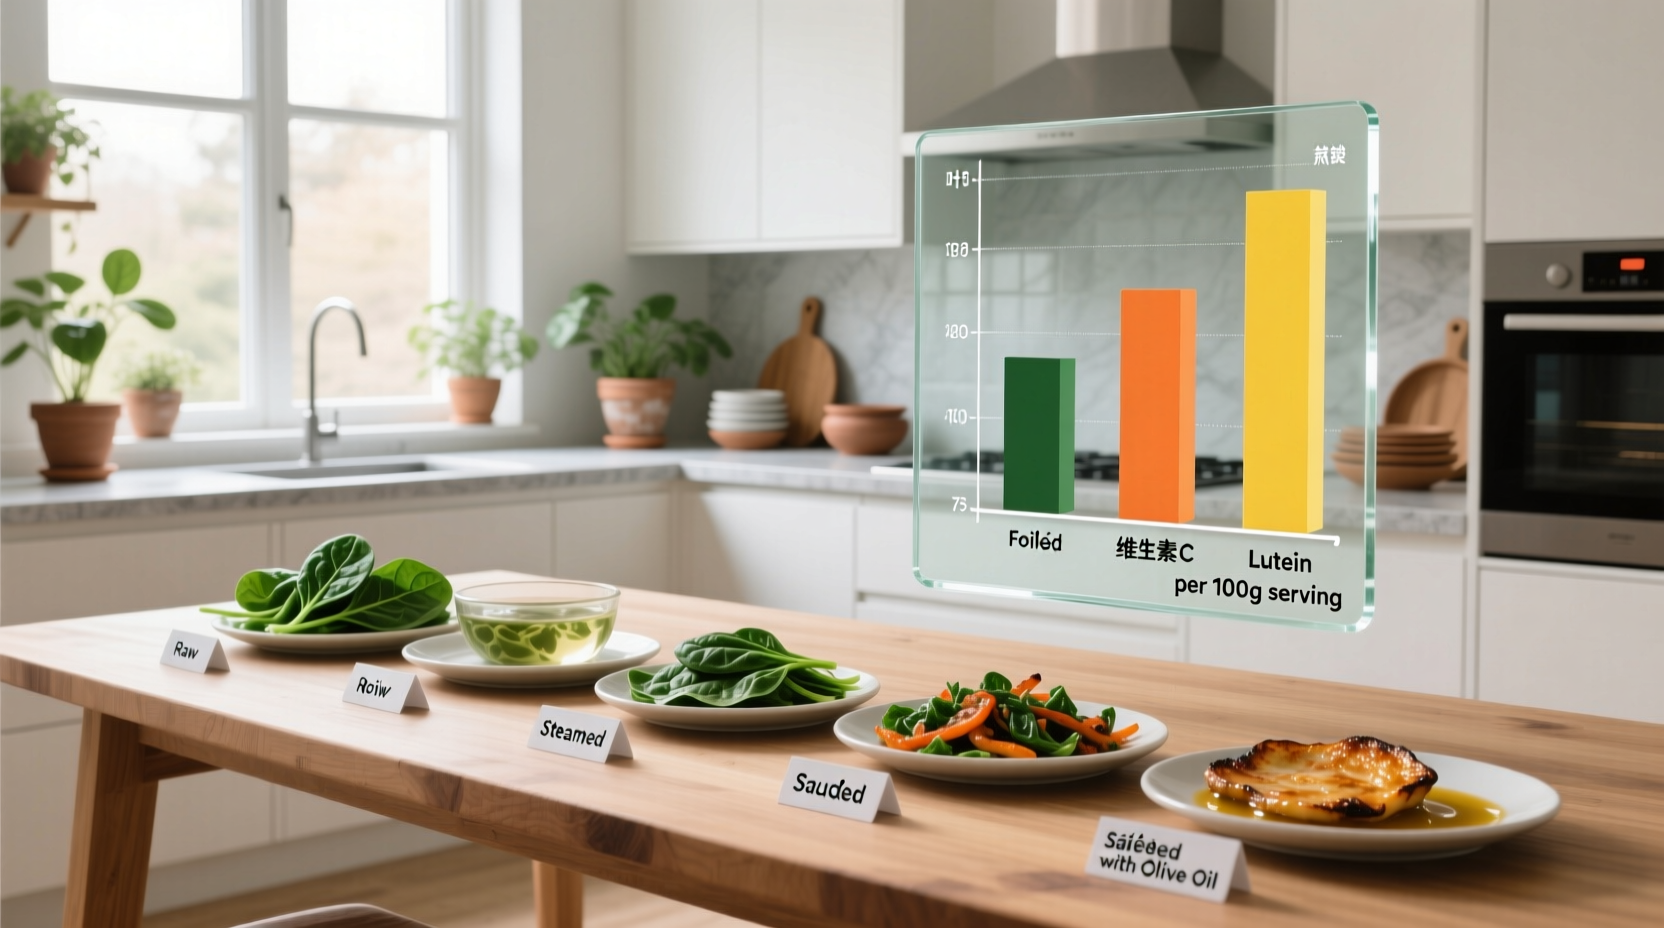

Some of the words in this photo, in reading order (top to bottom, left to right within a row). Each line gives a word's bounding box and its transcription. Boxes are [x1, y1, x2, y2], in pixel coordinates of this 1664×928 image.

[1116, 536, 1194, 562] 维生素C
[1249, 550, 1312, 573] Lutein
[1175, 578, 1207, 597] per
[1213, 578, 1262, 605] 100g
[1268, 585, 1342, 612] serving
[173, 641, 199, 660] Raw
[540, 719, 607, 748] Steamed
[1100, 854, 1136, 874] with
[1141, 859, 1187, 883] Olive
[1192, 869, 1218, 890] Oil
